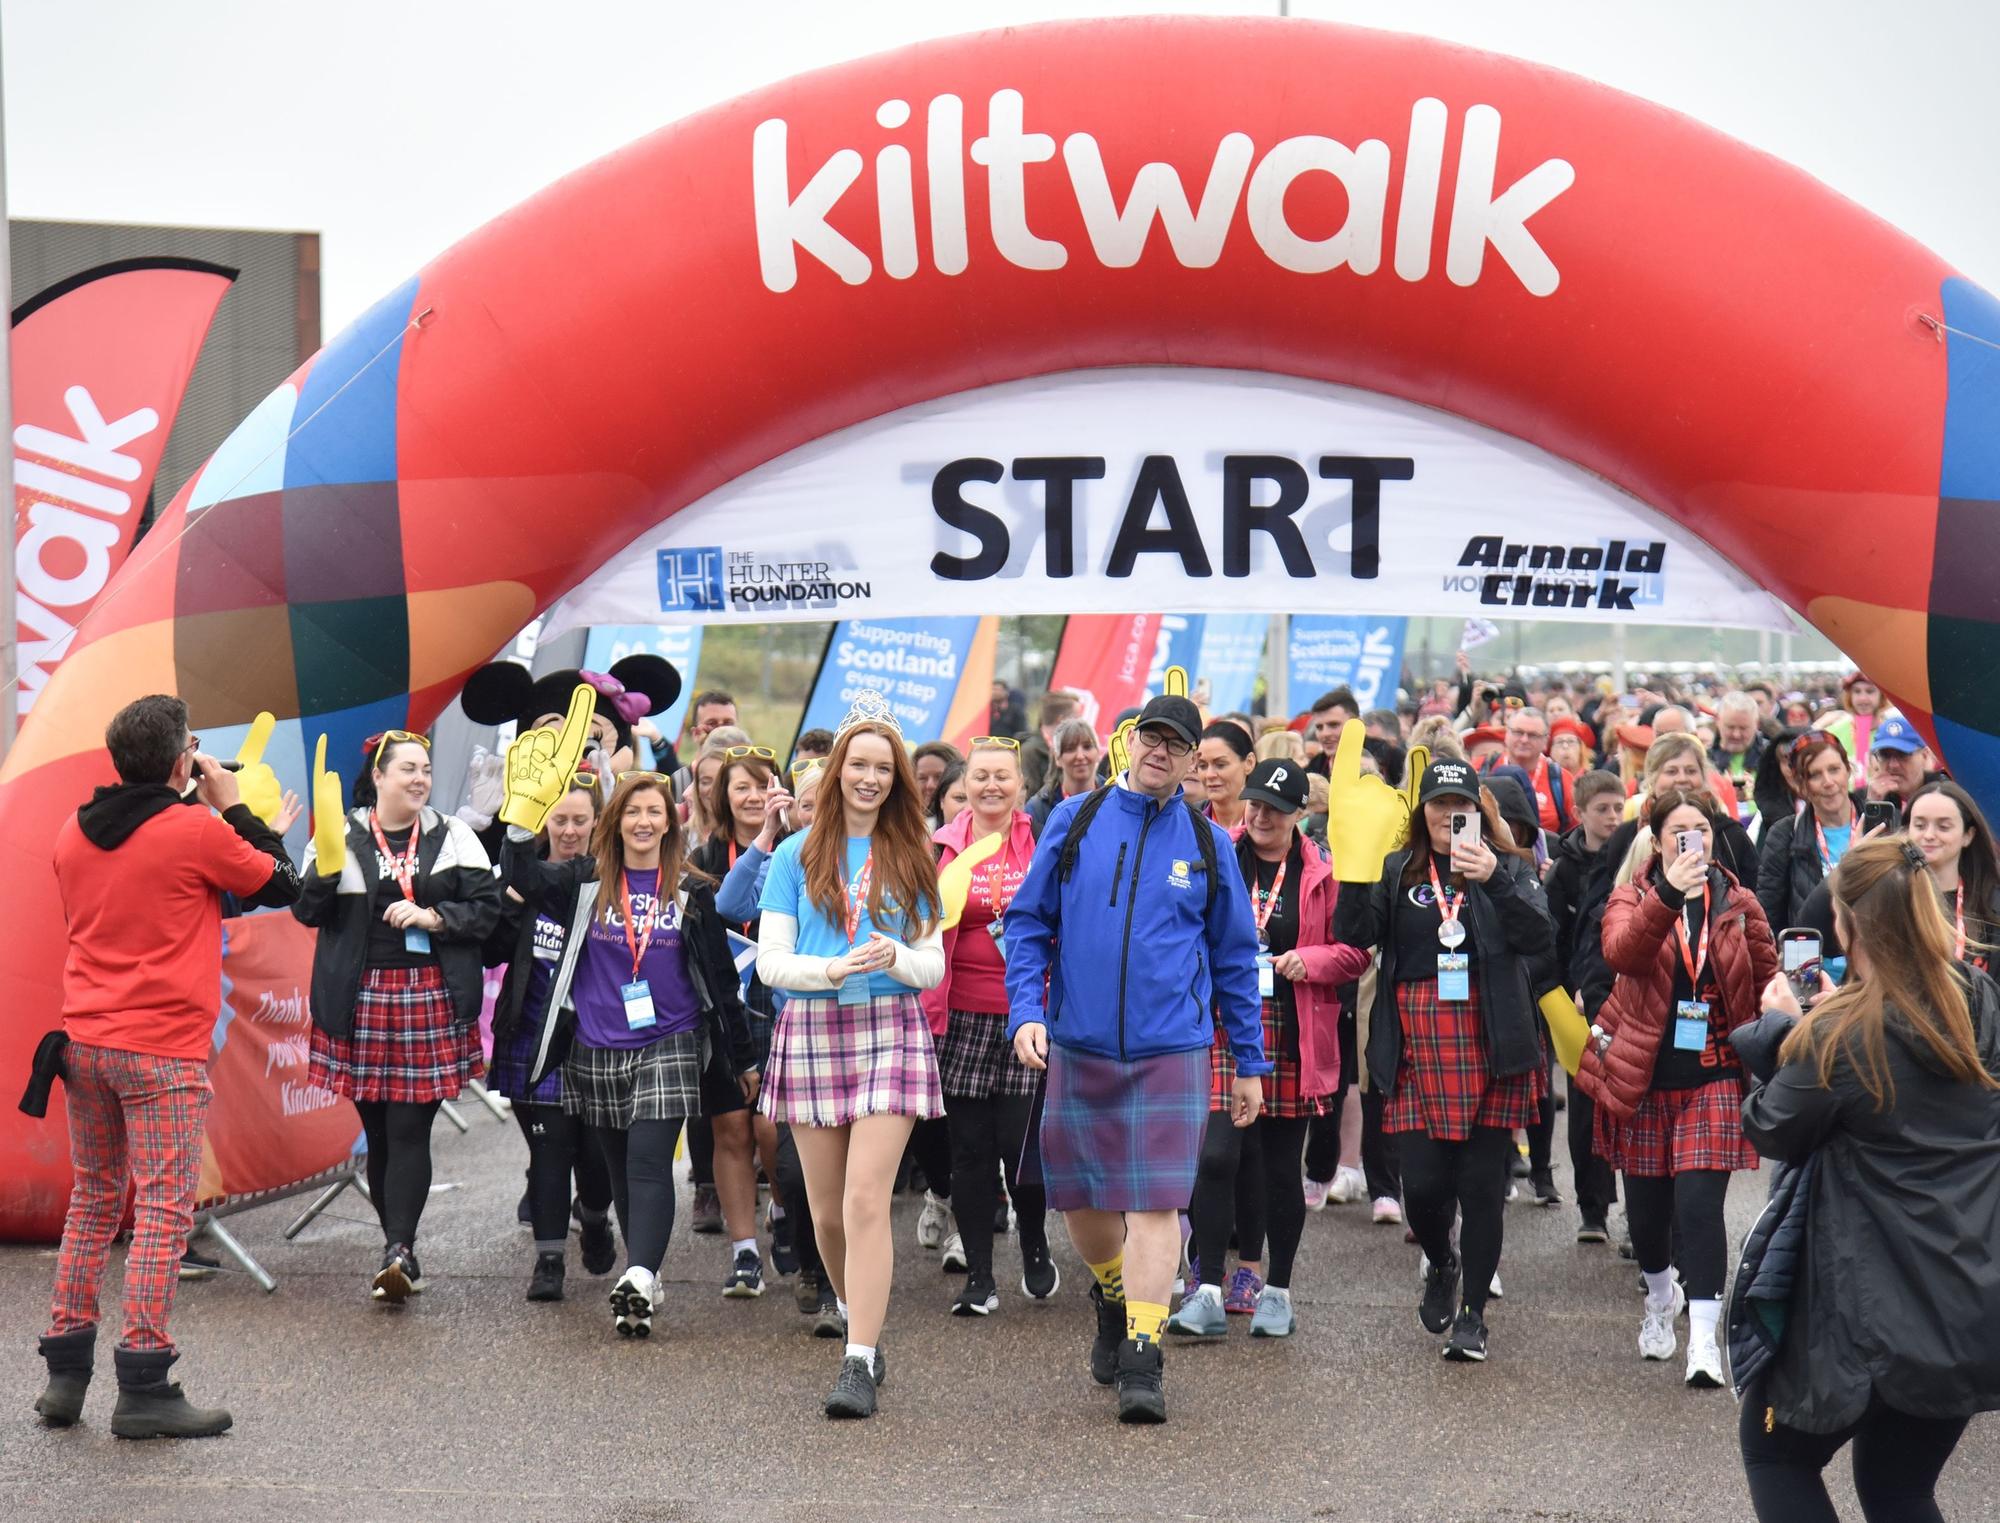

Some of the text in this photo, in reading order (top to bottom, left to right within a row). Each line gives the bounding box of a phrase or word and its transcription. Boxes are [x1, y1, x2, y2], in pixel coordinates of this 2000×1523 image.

[753, 89, 1576, 297] kiltwalk
[930, 455, 1415, 579] START
[729, 551, 754, 564] THE
[1457, 536, 1667, 573] Arnold
[729, 562, 831, 585] HUNTER
[730, 582, 871, 603] FOUNDATION
[1480, 574, 1639, 610] Clark
[848, 620, 952, 656] Supporting
[837, 641, 956, 678] Scotland
[845, 670, 896, 694] every
[896, 679, 937, 704] step
[893, 700, 930, 726] way
[251, 986, 303, 1023] Thank
